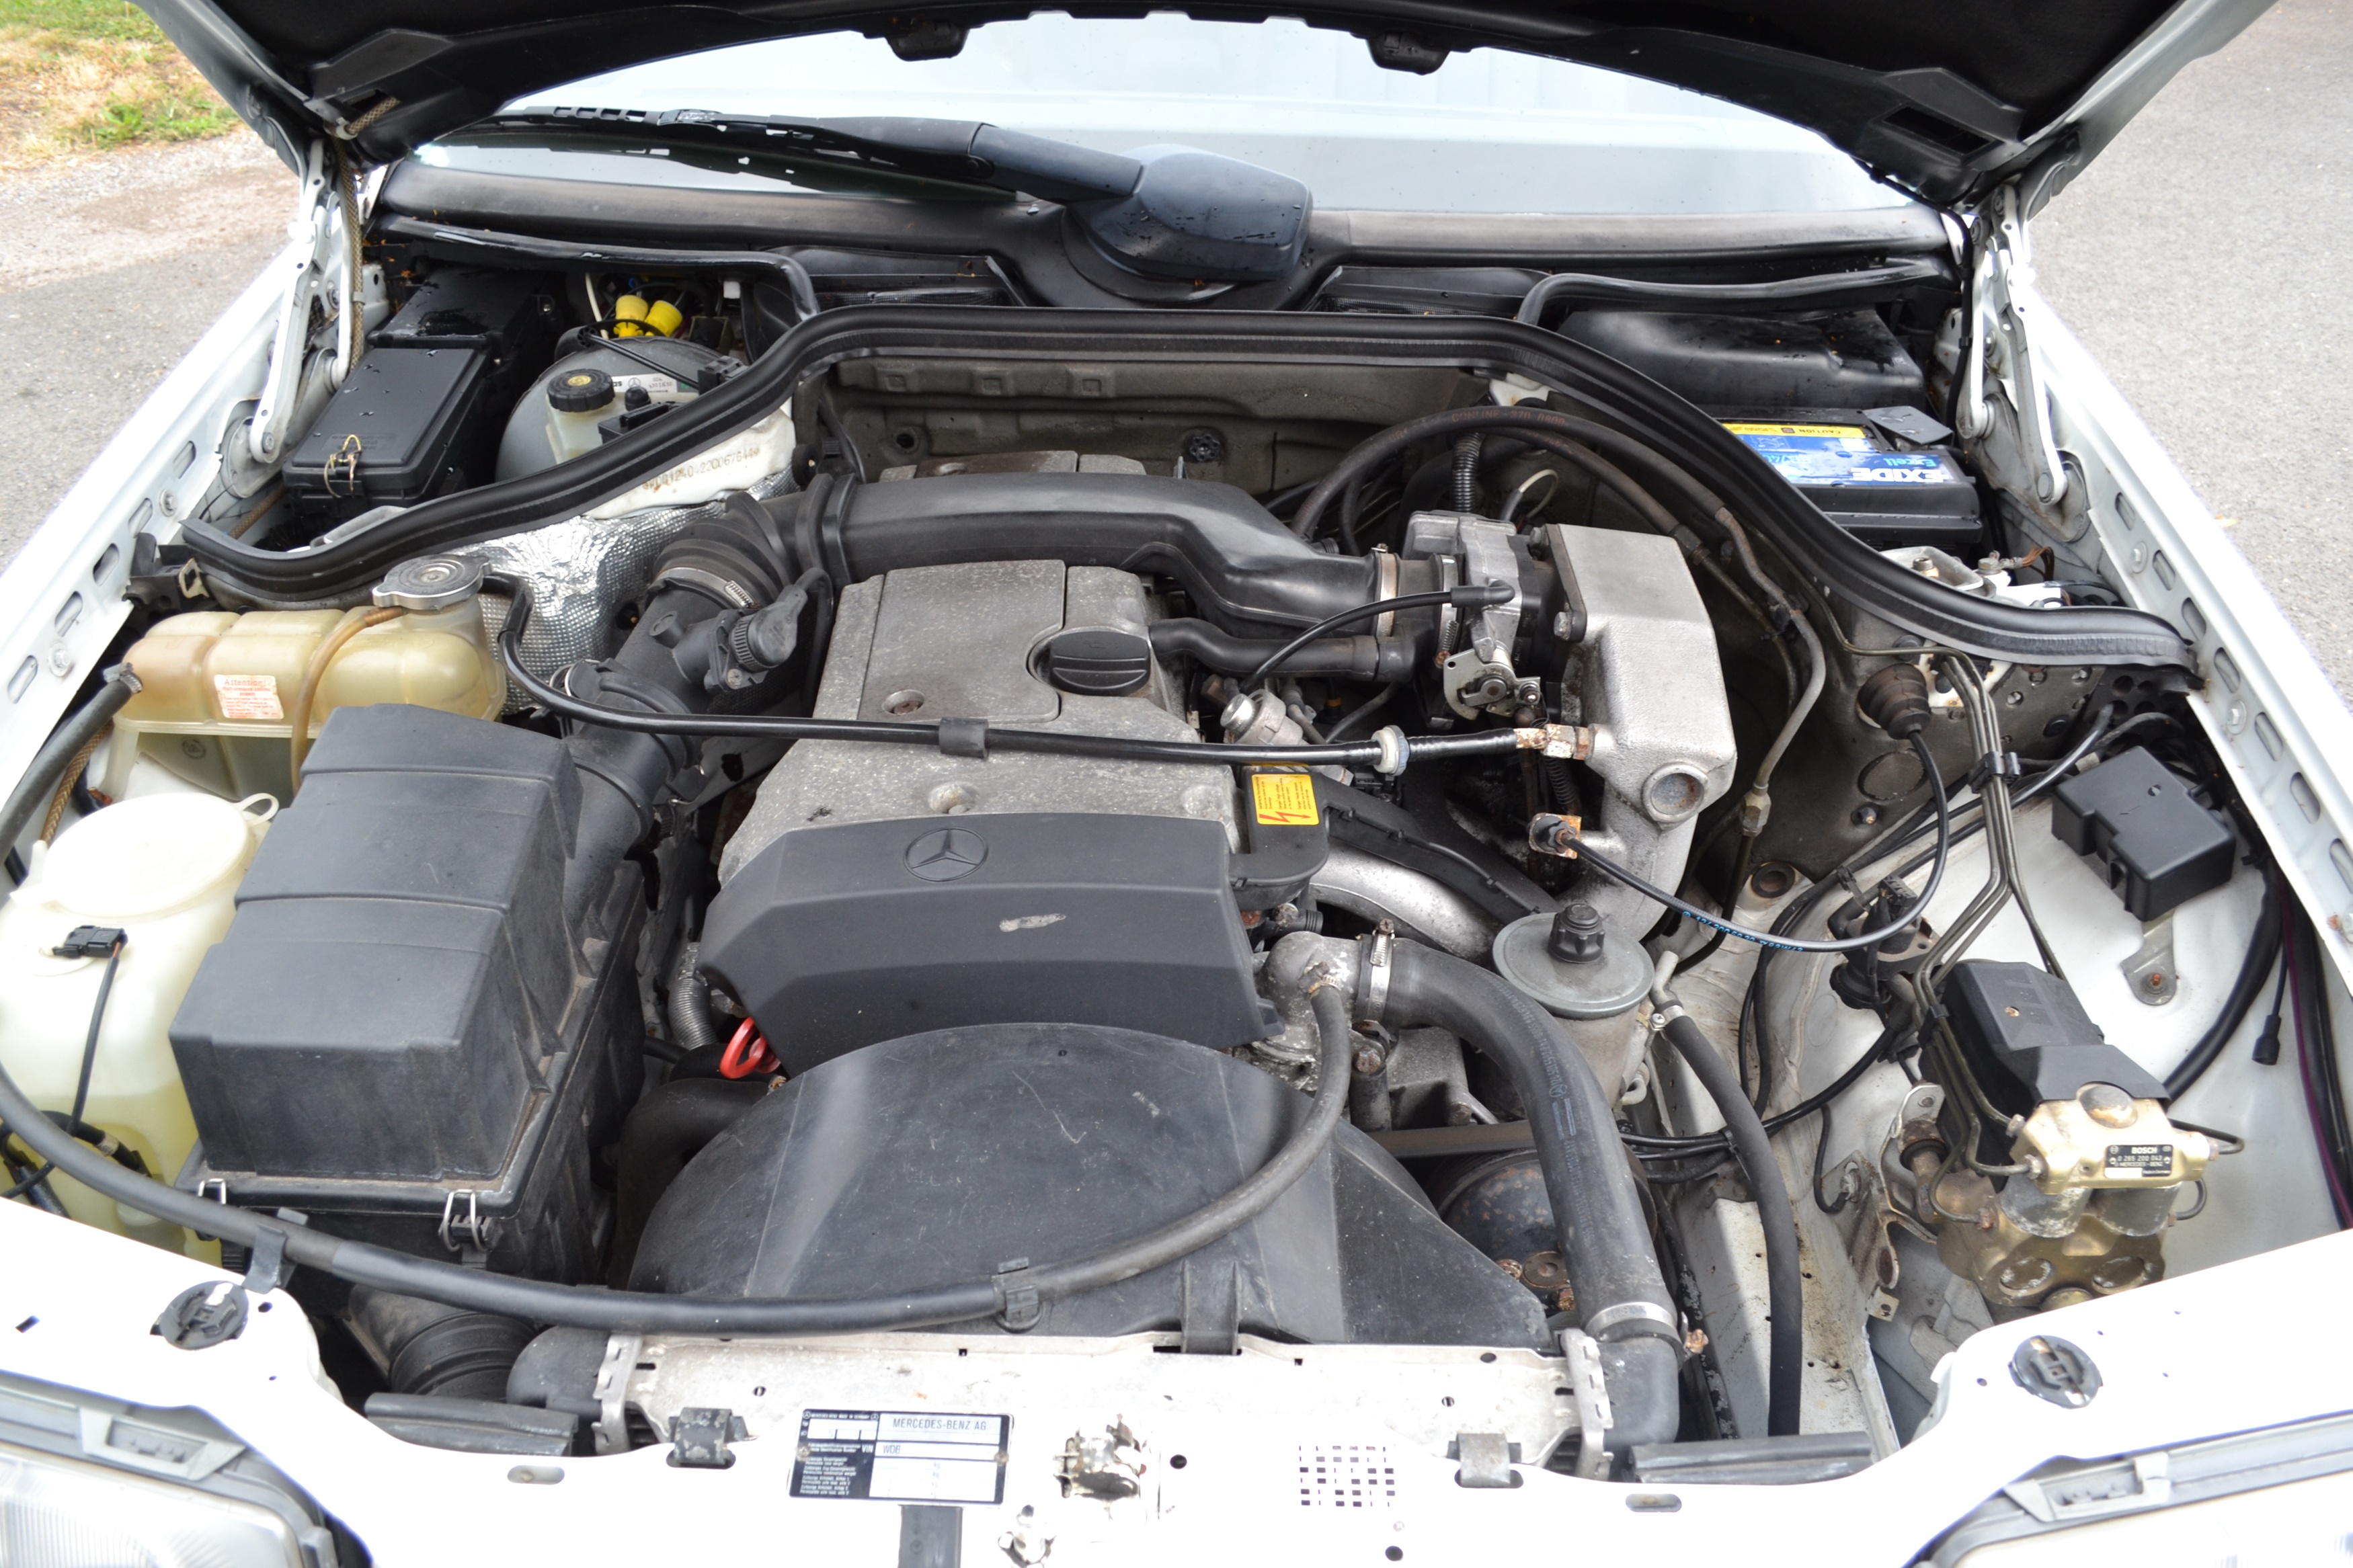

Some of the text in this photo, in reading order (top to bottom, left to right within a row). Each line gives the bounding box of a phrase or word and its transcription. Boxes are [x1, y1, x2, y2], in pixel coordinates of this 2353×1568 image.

[1883, 457, 1937, 467] Excell
[1850, 468, 1948, 483] EXIDE
[893, 1418, 987, 1431] MERCEDES-BENZ AG
[862, 1444, 873, 1453] VIN
[883, 1445, 901, 1454] WDB
